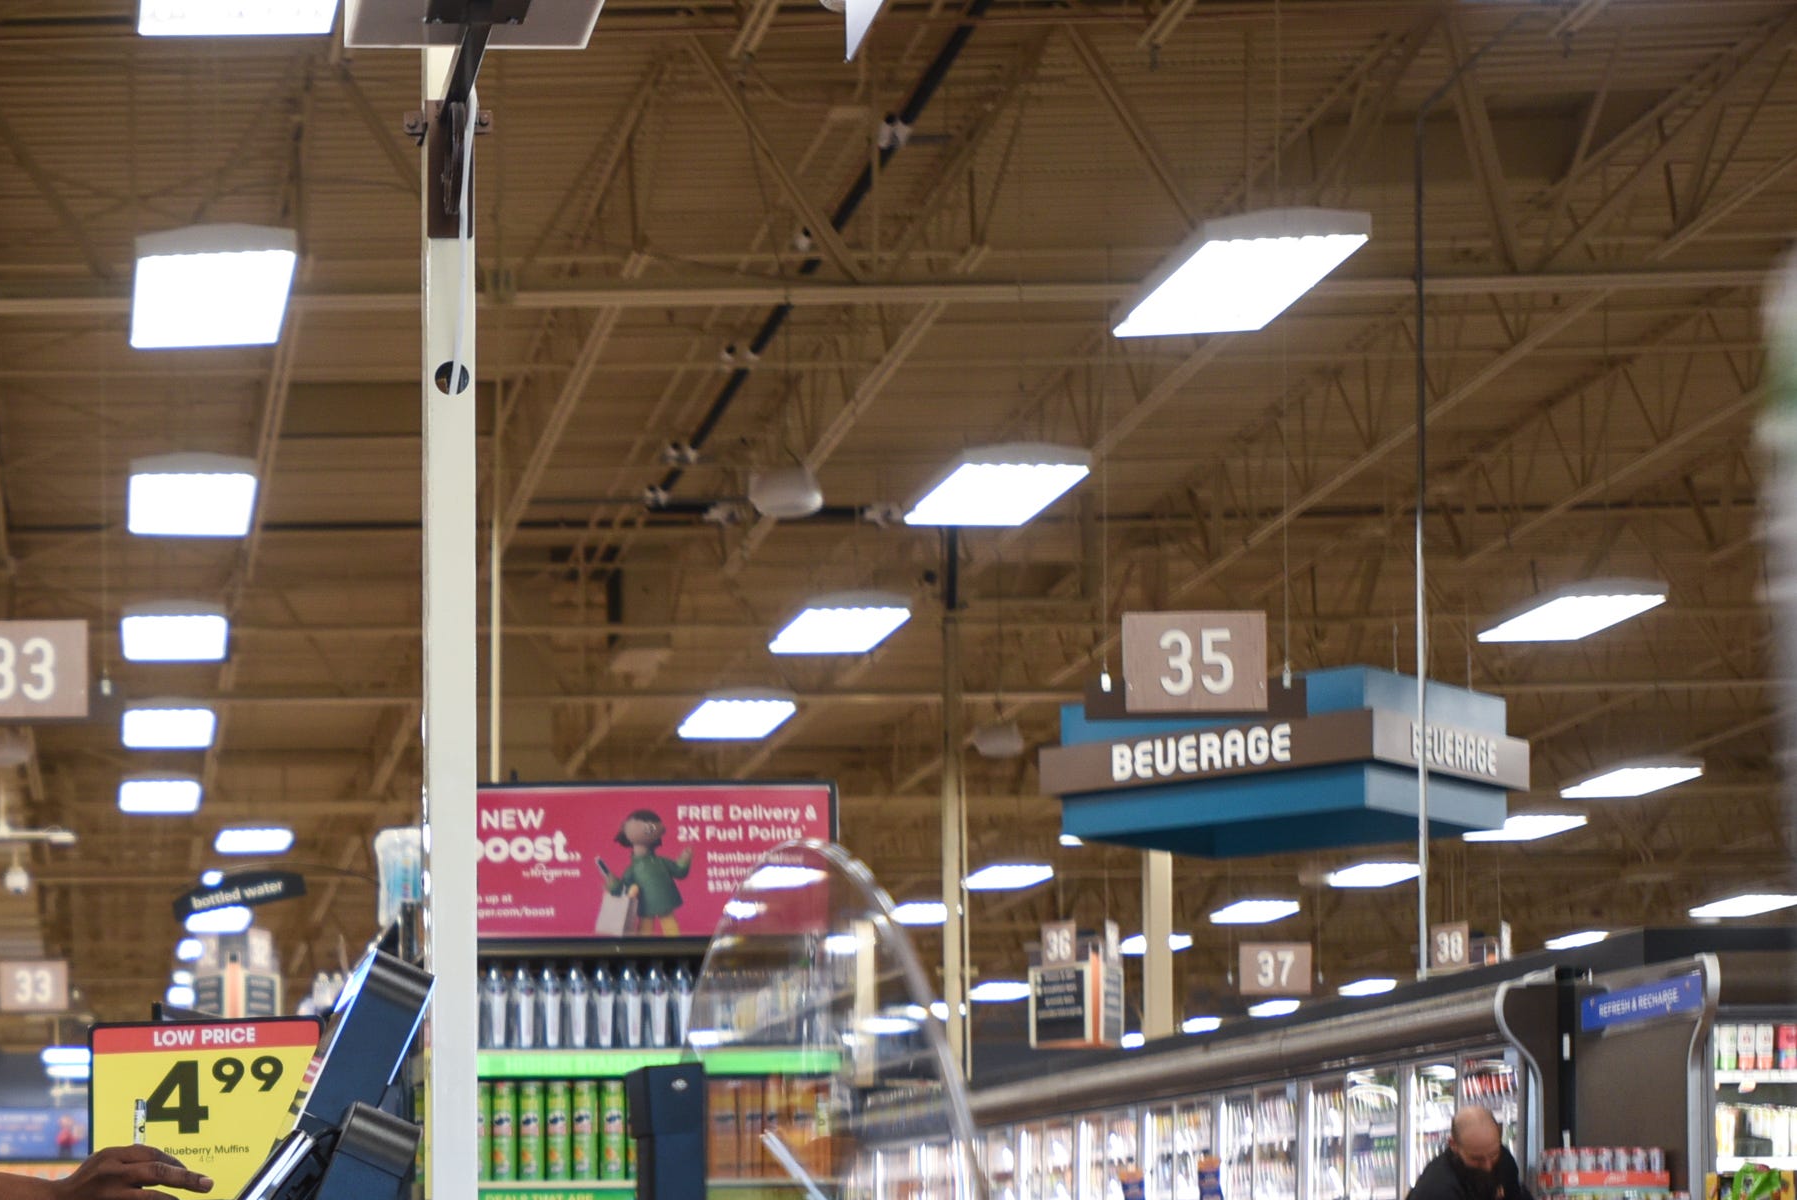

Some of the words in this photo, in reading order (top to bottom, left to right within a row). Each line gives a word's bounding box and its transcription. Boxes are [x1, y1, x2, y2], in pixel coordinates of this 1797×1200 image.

[1159, 627, 1234, 696] 35
[1111, 722, 1291, 783] BEVERAGE
[1410, 720, 1497, 777] BEVERAGE
[481, 807, 544, 830] NEW
[677, 805, 724, 821] FREE
[729, 804, 800, 823] Delivery
[804, 804, 817, 821] &
[677, 825, 700, 842] 2X
[705, 824, 743, 841] Fuel
[191, 888, 241, 909] bottled
[244, 881, 283, 898] water
[485, 894, 498, 904] up
[501, 893, 512, 903] at
[1046, 929, 1071, 961] 36
[1436, 931, 1464, 964] 38
[1257, 950, 1294, 987] 37
[14, 969, 52, 1003] 33
[1599, 999, 1630, 1017] REFRESH
[1638, 987, 1679, 1010] RECHARGE
[153, 1029, 195, 1047] LOW
[201, 1026, 256, 1045] PRICE
[164, 1145, 211, 1156] Blueberry
[214, 1144, 250, 1155] Muffins
